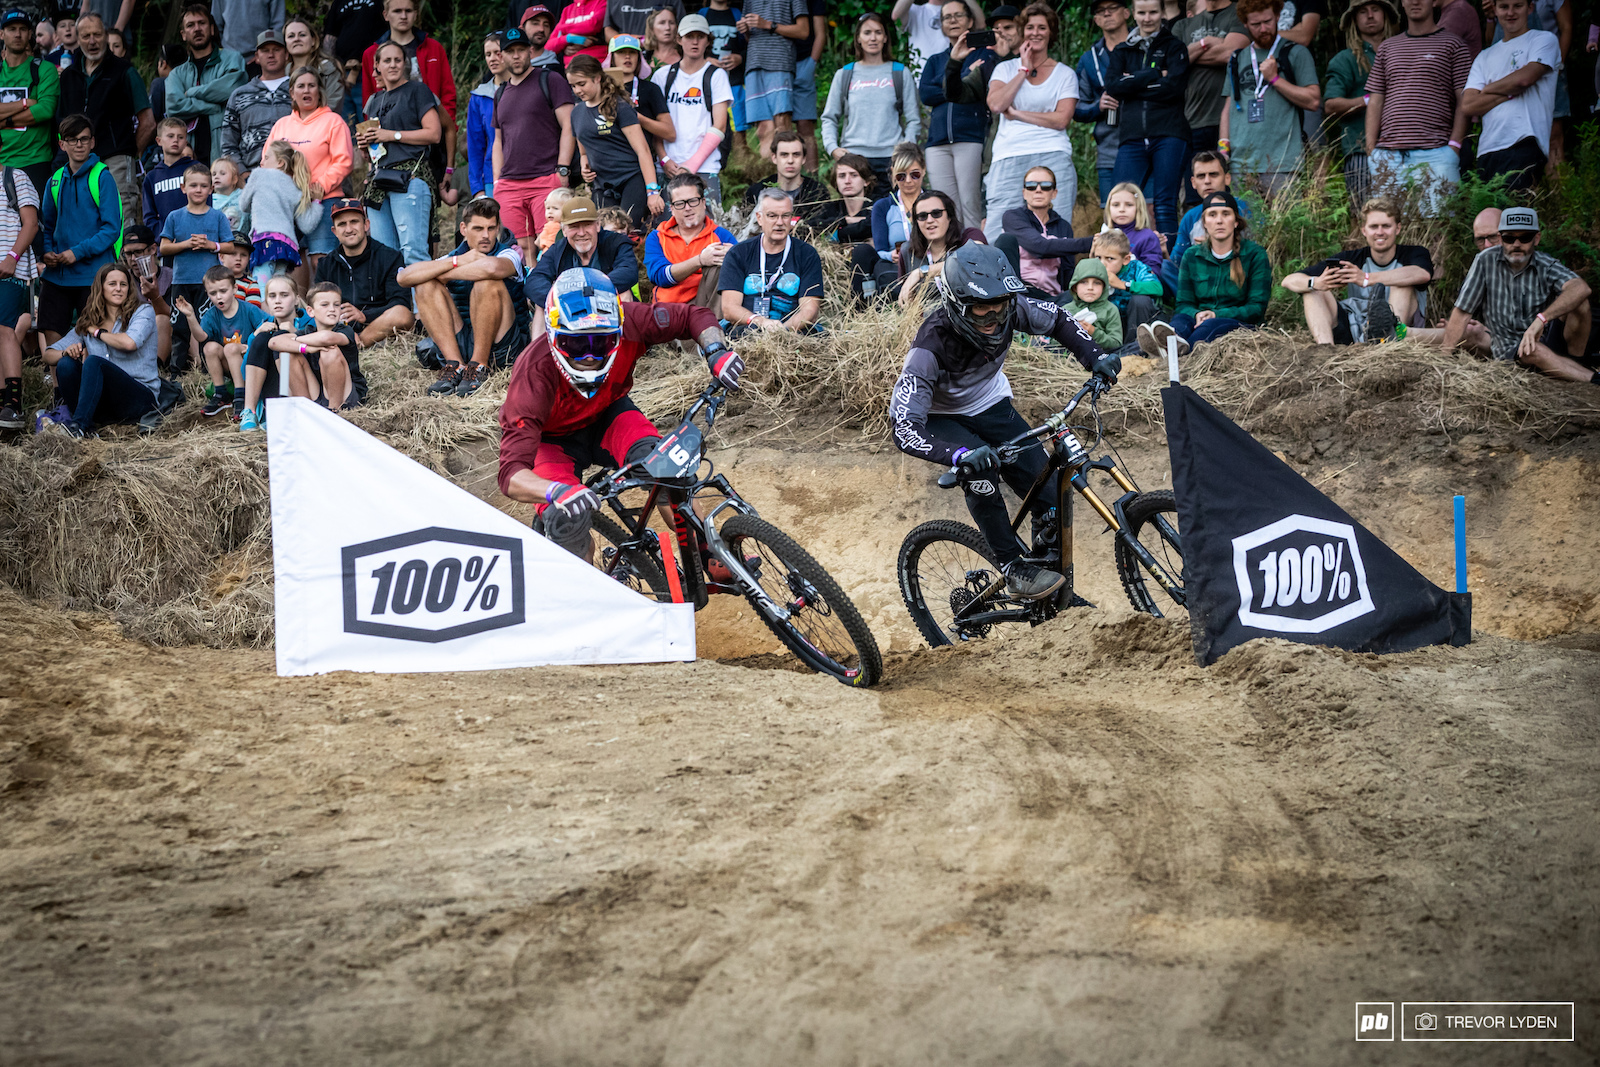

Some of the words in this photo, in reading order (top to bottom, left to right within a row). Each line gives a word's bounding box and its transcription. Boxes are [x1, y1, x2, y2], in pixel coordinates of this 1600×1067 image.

[668, 443, 690, 467] 6
[371, 555, 500, 615] 100%
[1258, 541, 1351, 609] 100%
